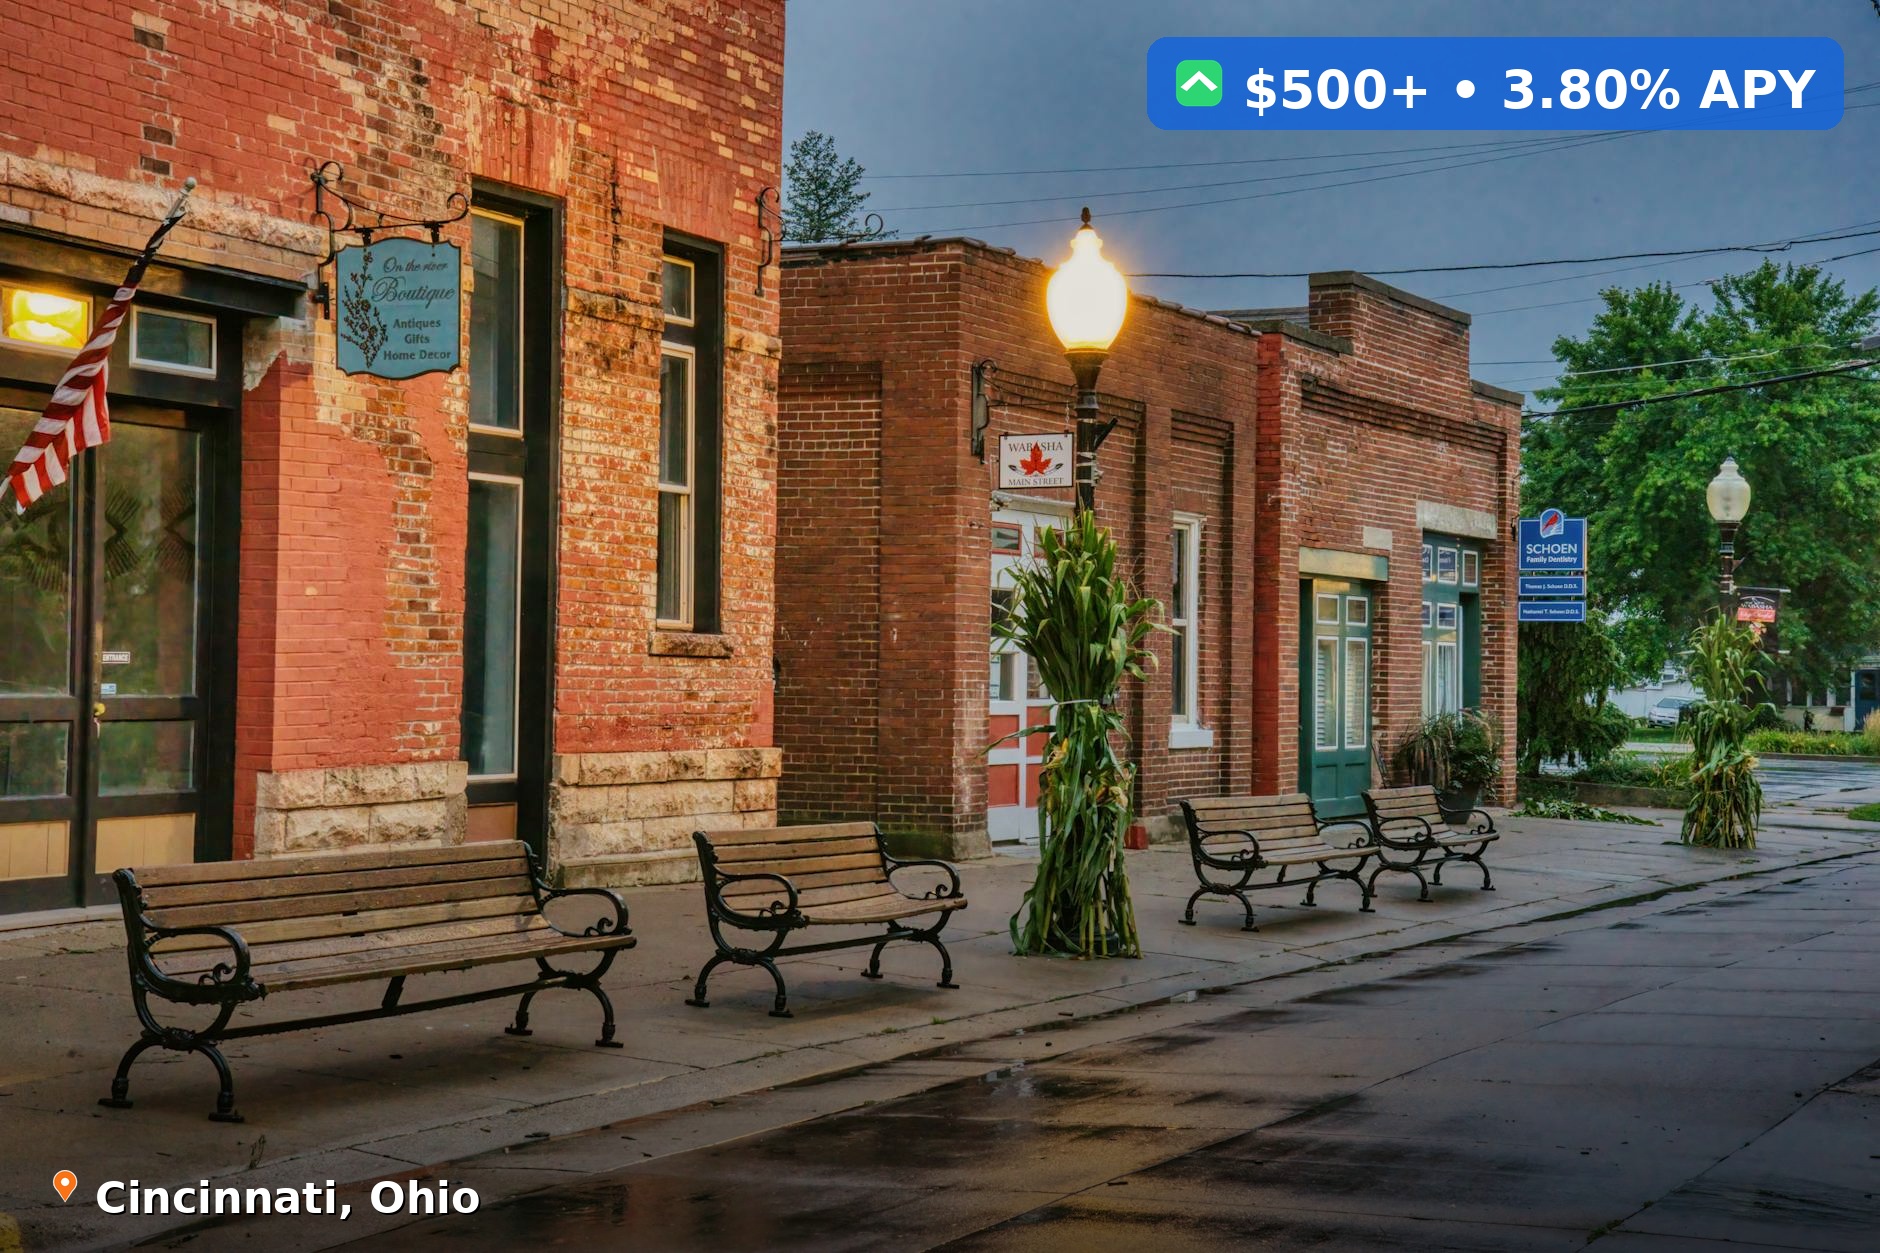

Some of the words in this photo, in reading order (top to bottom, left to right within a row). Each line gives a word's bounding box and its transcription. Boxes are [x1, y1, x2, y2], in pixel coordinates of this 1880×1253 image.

[383, 256, 402, 273] On
[405, 259, 421, 272] the
[422, 261, 448, 272] river
[371, 276, 455, 309] Boutique
[392, 318, 441, 330] Antiques
[404, 333, 430, 344] Gifts
[383, 350, 416, 361] Home
[419, 349, 452, 360] Decor
[1008, 478, 1031, 486] MAIN
[1032, 477, 1064, 486] STREET
[1526, 543, 1578, 554] SCHOEN
[1526, 556, 1547, 564] Family
[1548, 556, 1578, 564] Dentistry
